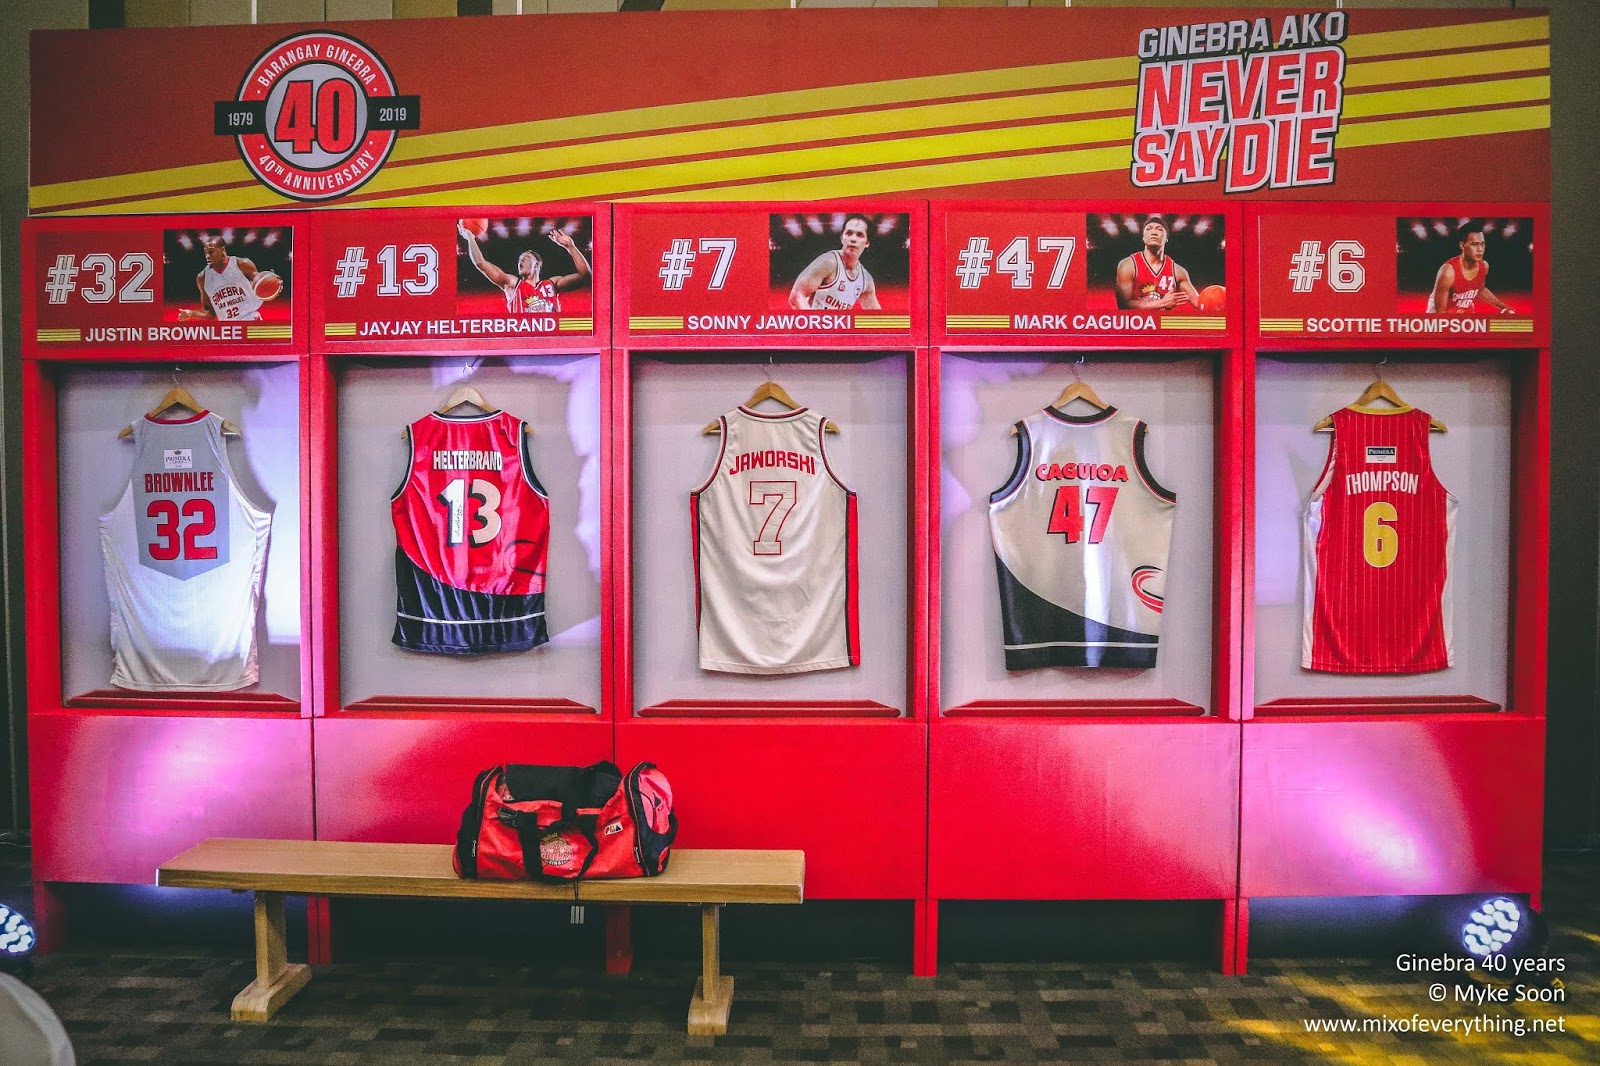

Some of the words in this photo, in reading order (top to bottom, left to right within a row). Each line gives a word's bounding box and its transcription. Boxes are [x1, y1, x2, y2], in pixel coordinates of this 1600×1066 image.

[1138, 18, 1270, 58] GINEBRA
[1279, 11, 1346, 46] AKO
[257, 44, 321, 88] BARANGAY
[326, 45, 376, 85] GINEBRA
[1137, 46, 1344, 132] NEVER
[228, 112, 253, 126] 1979
[274, 78, 357, 154] 40
[379, 107, 407, 122] 2019
[259, 154, 285, 176] 40TH
[283, 150, 375, 191] ANNIVERSARY
[1132, 125, 1229, 187] SAY
[1225, 116, 1338, 192] DIE
[45, 252, 154, 304] #32
[334, 244, 439, 298] #13
[658, 237, 737, 291] #7
[956, 236, 1076, 290] #47
[1159, 275, 1175, 291] 47
[1289, 240, 1366, 293] #6
[540, 284, 555, 298] 13
[226, 306, 240, 319] 32
[359, 320, 422, 336] JAYJAY
[427, 318, 556, 334] HELTERBRAND
[687, 315, 751, 330] SONNY
[756, 315, 851, 330] JAWORSKI
[1014, 315, 1068, 330] MARK
[1073, 315, 1157, 330] CAGUIOA
[1307, 318, 1382, 333] SCOTTIE
[1387, 318, 1487, 333] THOMPSON
[85, 327, 142, 342] JUSTIN
[148, 325, 242, 341] BROWNLEE
[433, 450, 503, 471] HELTERBRAND
[729, 450, 816, 475] JAWORSKI
[1036, 463, 1129, 482] CAGUIOA
[144, 471, 214, 493] BROWNLEE
[1346, 471, 1419, 495] THOMPSON
[146, 498, 218, 561] 32
[436, 478, 502, 548] 13
[749, 480, 797, 556] 7
[1047, 485, 1119, 544] 47
[1363, 501, 1399, 569] 6
